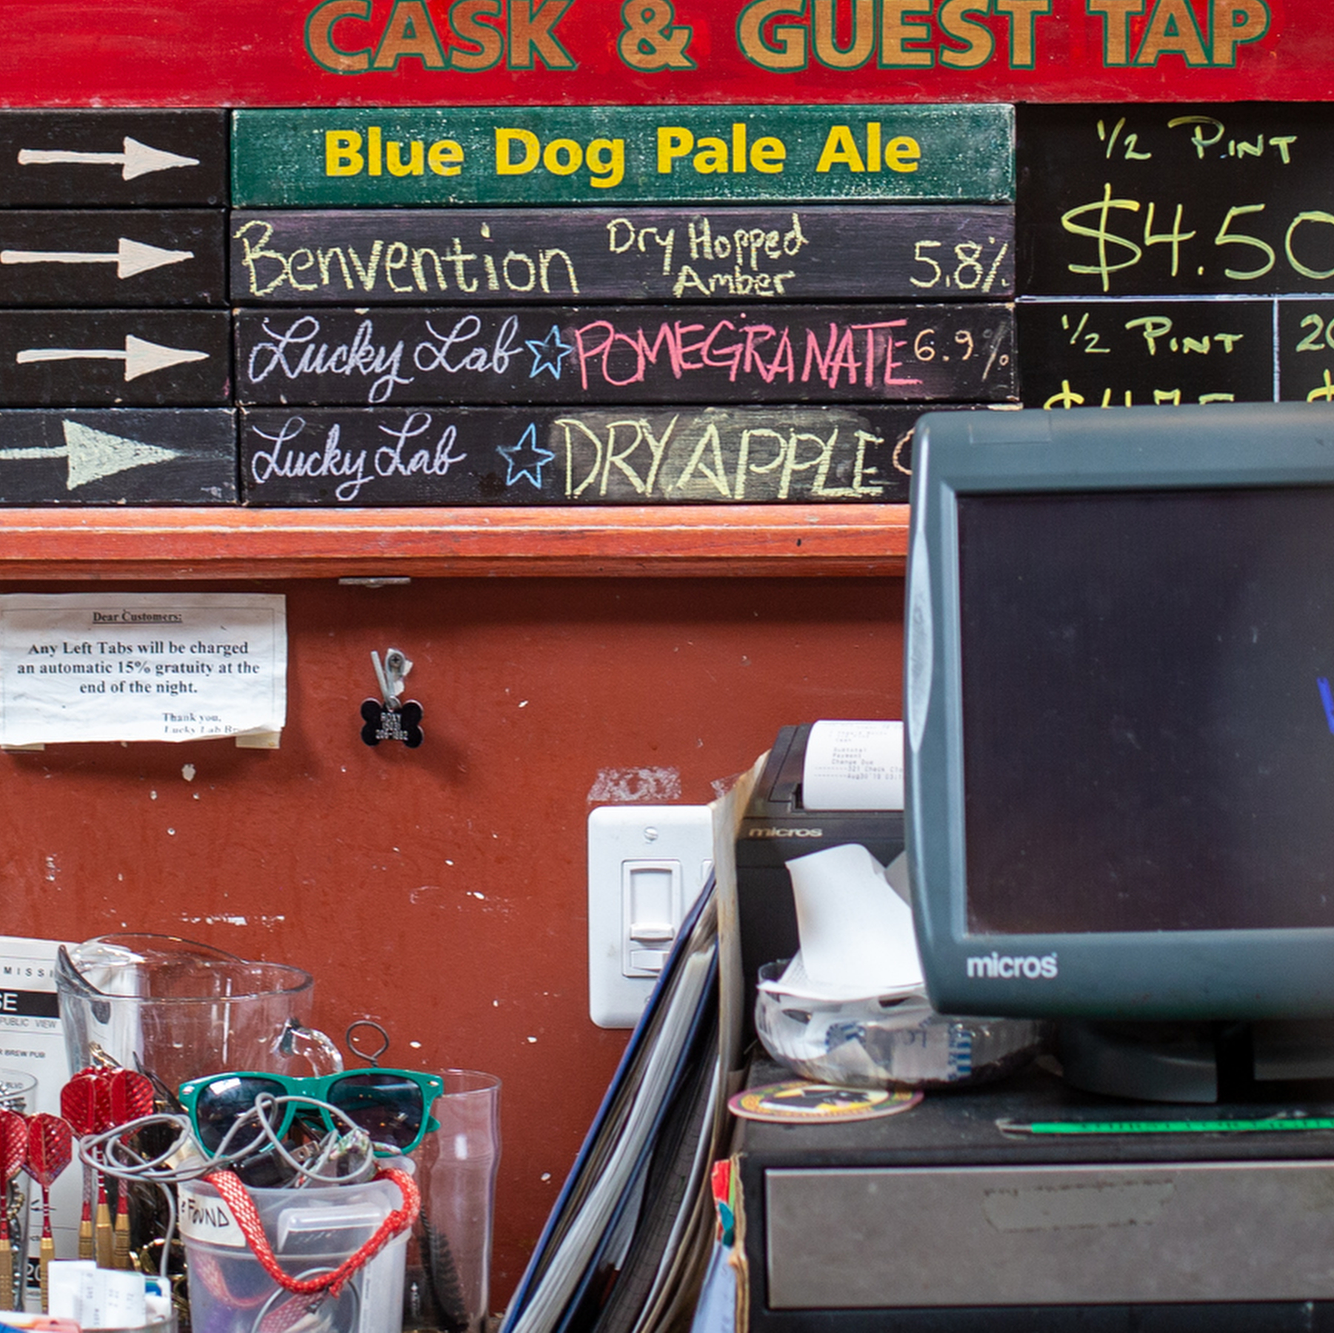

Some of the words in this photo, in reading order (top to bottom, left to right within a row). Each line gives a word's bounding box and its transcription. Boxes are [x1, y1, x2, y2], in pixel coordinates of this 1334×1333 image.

[324, 126, 465, 177] Blue
[494, 126, 626, 188] Dog
[656, 126, 788, 176] Pale
[815, 124, 922, 173] Ale
[233, 219, 581, 298] Benvention
[606, 218, 674, 276] Dry
[688, 212, 809, 263] Hopped
[910, 237, 1010, 296] 5.8%
[673, 265, 797, 300] Amber
[248, 314, 415, 403] Lucky
[413, 314, 522, 380] Lab
[572, 319, 923, 391] POMEGRANATE
[251, 415, 375, 503] Lucky
[372, 411, 467, 480] Lab
[553, 416, 679, 501] DRY
[667, 418, 886, 499] APPLE
[28, 641, 58, 657] Any
[62, 641, 92, 655] Left
[98, 641, 133, 655] Tabs
[137, 641, 165, 655] will
[169, 641, 185, 655] be
[190, 641, 249, 657] charged
[39, 662, 113, 675] automatic
[117, 661, 151, 675] 15%
[155, 662, 214, 677] gratuity
[748, 826, 823, 839] micros
[967, 952, 1058, 979] micros
